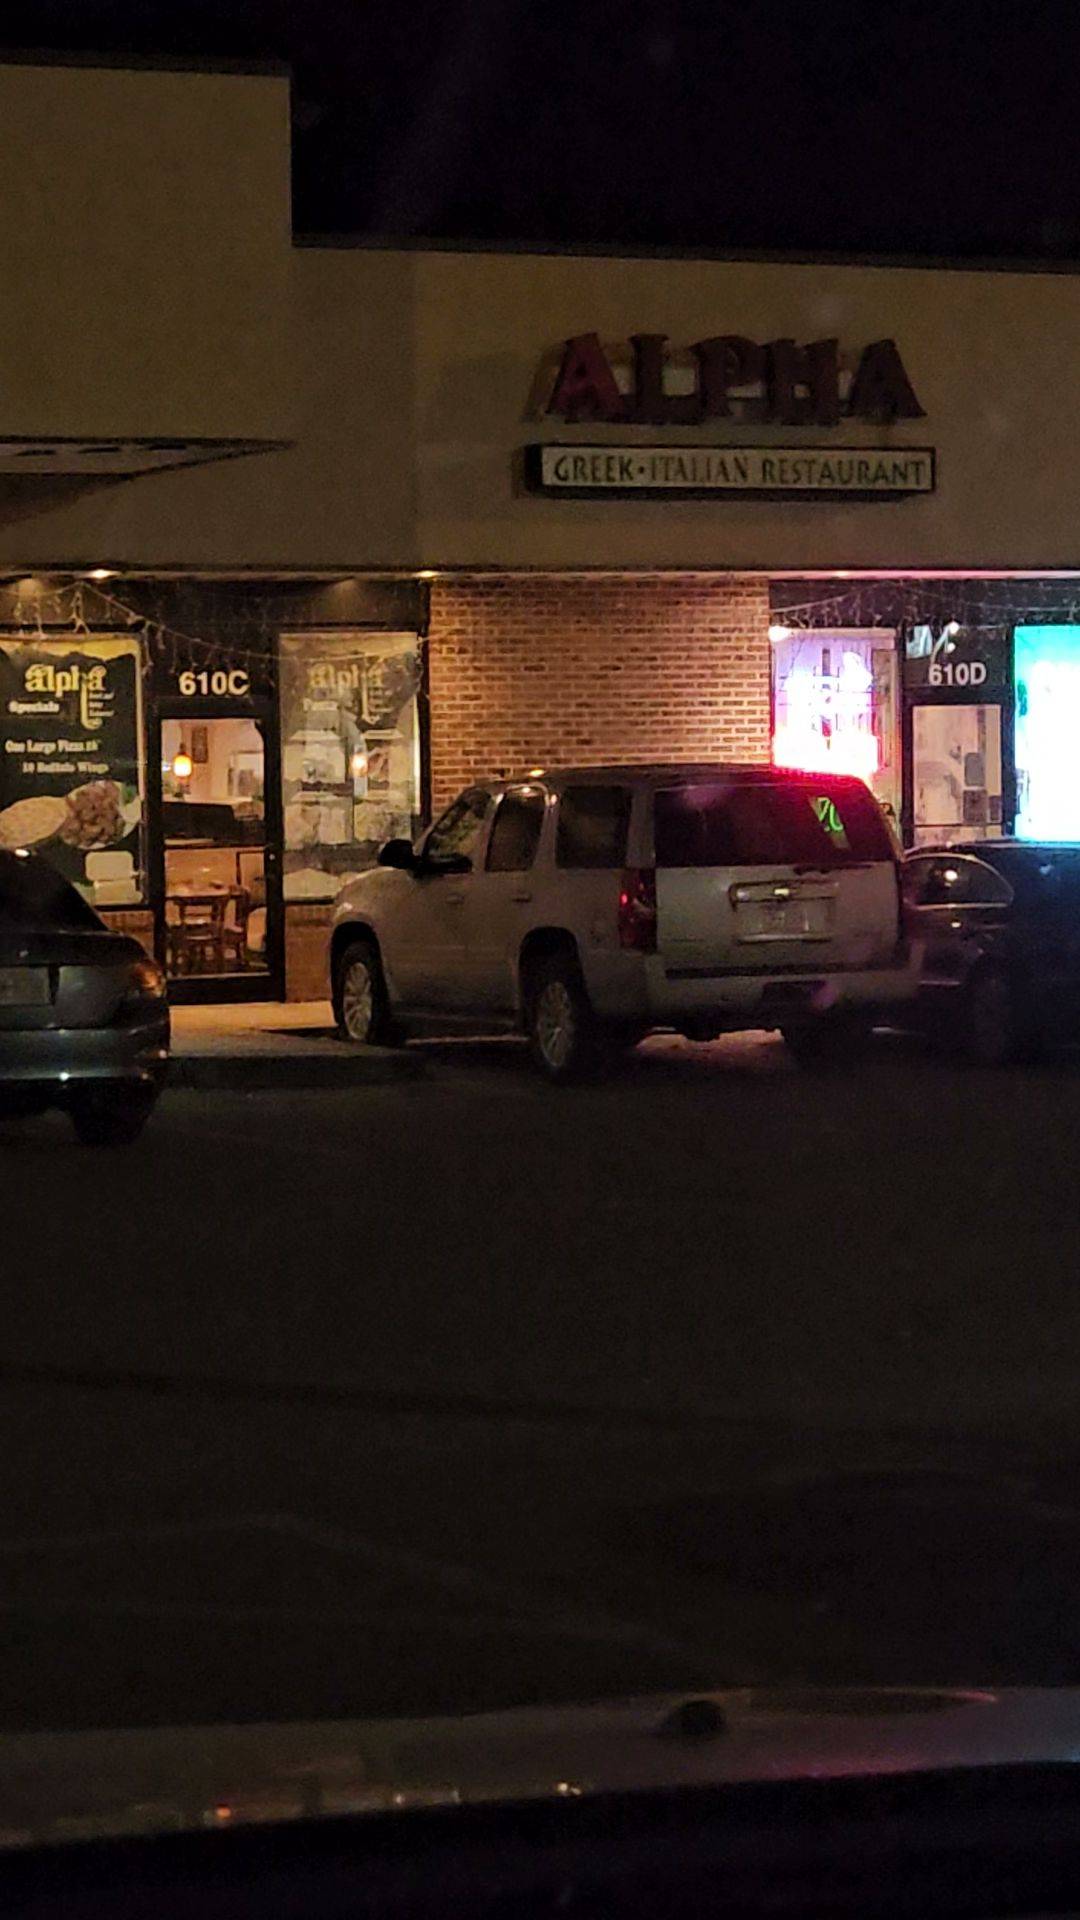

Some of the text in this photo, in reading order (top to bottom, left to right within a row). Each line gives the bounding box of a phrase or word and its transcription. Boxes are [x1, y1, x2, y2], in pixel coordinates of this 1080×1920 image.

[546, 332, 928, 425] ALPHA
[762, 460, 926, 486] RESTAURANT
[178, 669, 249, 696] 610C
[928, 662, 987, 686] 610D
